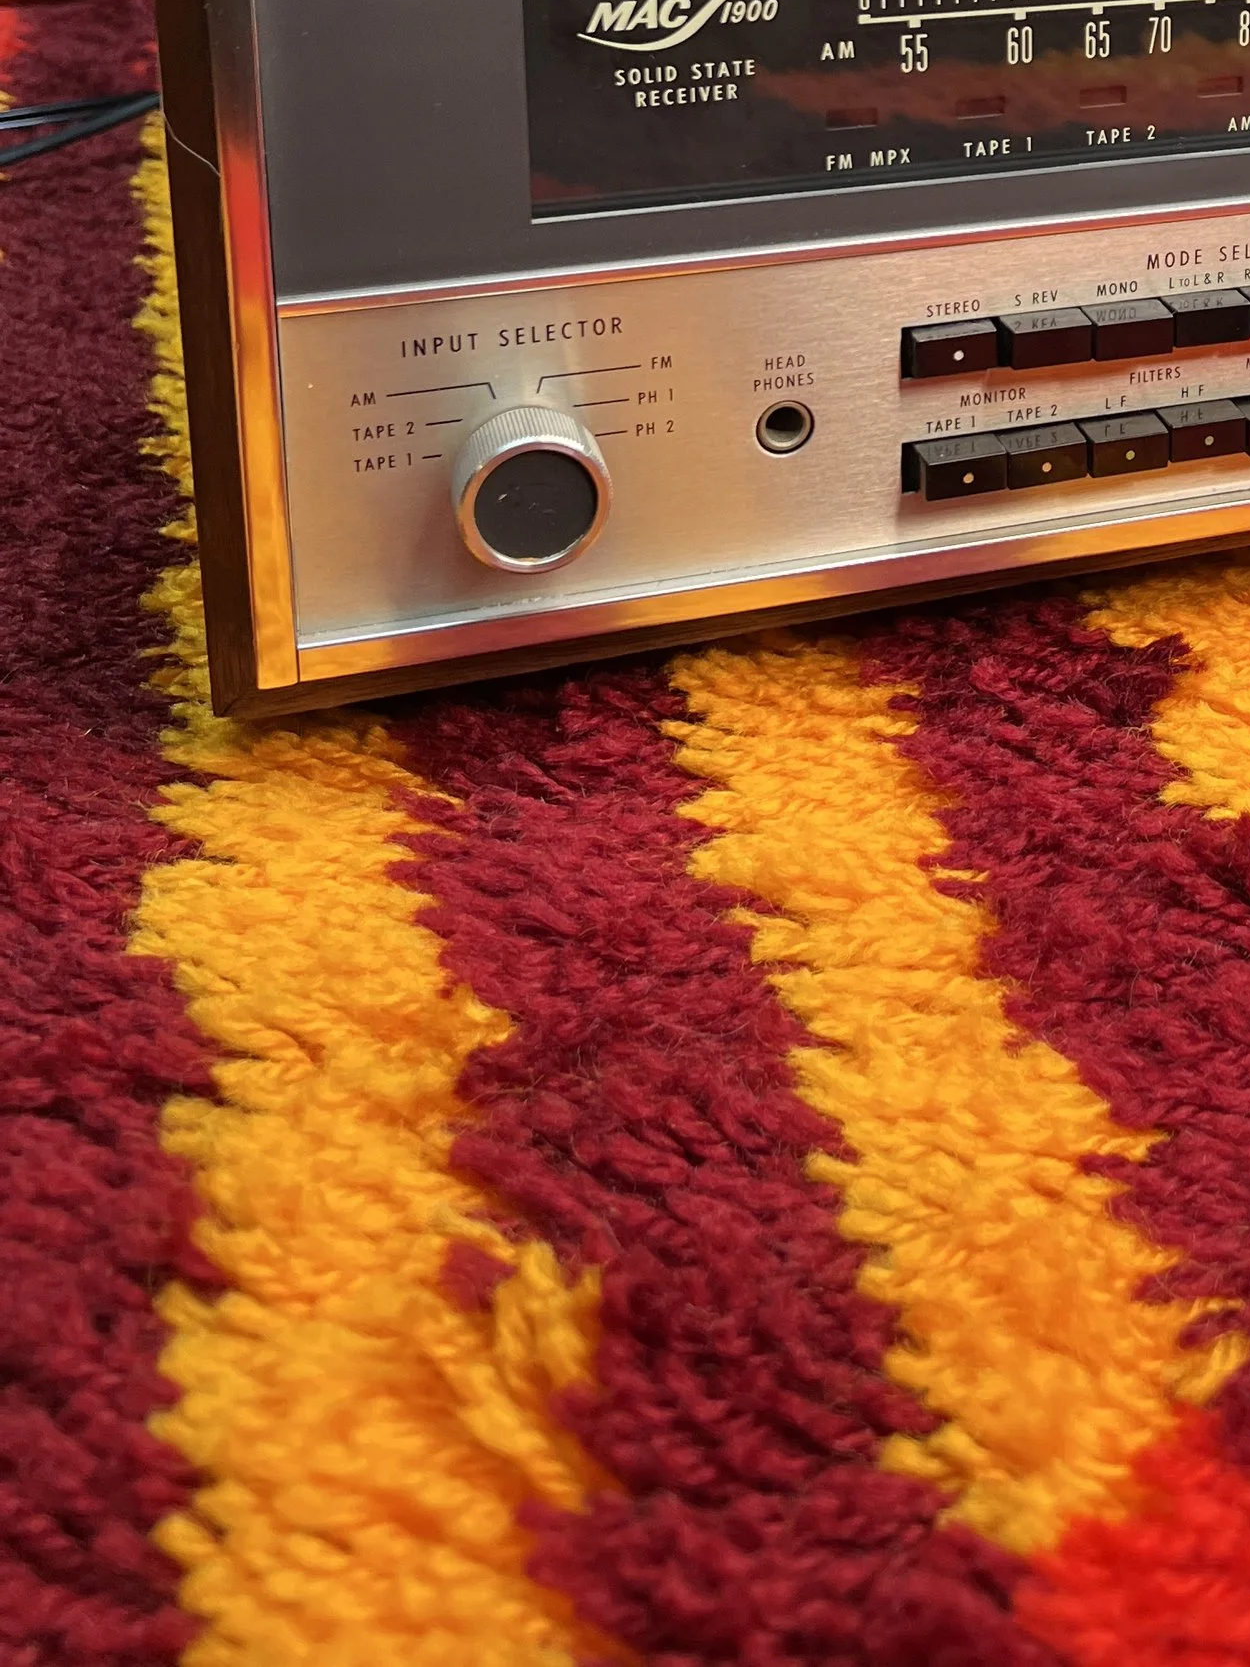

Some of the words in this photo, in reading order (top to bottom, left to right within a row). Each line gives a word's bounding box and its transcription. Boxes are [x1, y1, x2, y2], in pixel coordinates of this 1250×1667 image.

[820, 41, 855, 60] AM
[900, 34, 929, 73] 55
[1007, 26, 1033, 65] 60
[1085, 21, 1110, 59] 65
[1149, 16, 1172, 54] 70
[614, 66, 678, 87] SOLID
[691, 59, 756, 80] STATE
[635, 84, 739, 109] RECEIVER
[1086, 128, 1131, 146] TAPE
[1147, 125, 1156, 141] 2
[964, 141, 1011, 158] TAPE
[1026, 136, 1033, 152] 1
[826, 154, 853, 172] FM
[870, 148, 911, 167] MPX
[1146, 250, 1203, 270] MODE
[1204, 274, 1212, 285] &
[1217, 272, 1225, 284] R
[1244, 268, 1250, 279] R
[1015, 294, 1022, 306] S
[1032, 290, 1058, 305] REV
[1096, 281, 1138, 297] MONO
[926, 299, 981, 318] STEREO
[401, 332, 479, 358] INPUT
[499, 317, 624, 348] SELECTOR
[651, 356, 673, 369] FM
[764, 354, 806, 371] HEAD
[753, 372, 814, 392] PHONES
[1129, 367, 1181, 384] FILTERS
[351, 391, 377, 407] AM
[637, 390, 658, 405] PH
[669, 388, 674, 402] 1
[960, 388, 1026, 407] MONITOR
[1007, 408, 1041, 423] TAPE
[1050, 405, 1057, 416] 2
[352, 424, 396, 442] TAPE
[406, 421, 415, 436] 2
[635, 423, 657, 436] PH
[665, 420, 675, 434] 2
[926, 419, 962, 434] TAPE
[971, 416, 976, 427] 1
[353, 455, 397, 473] TAPE
[406, 453, 412, 466] 1
